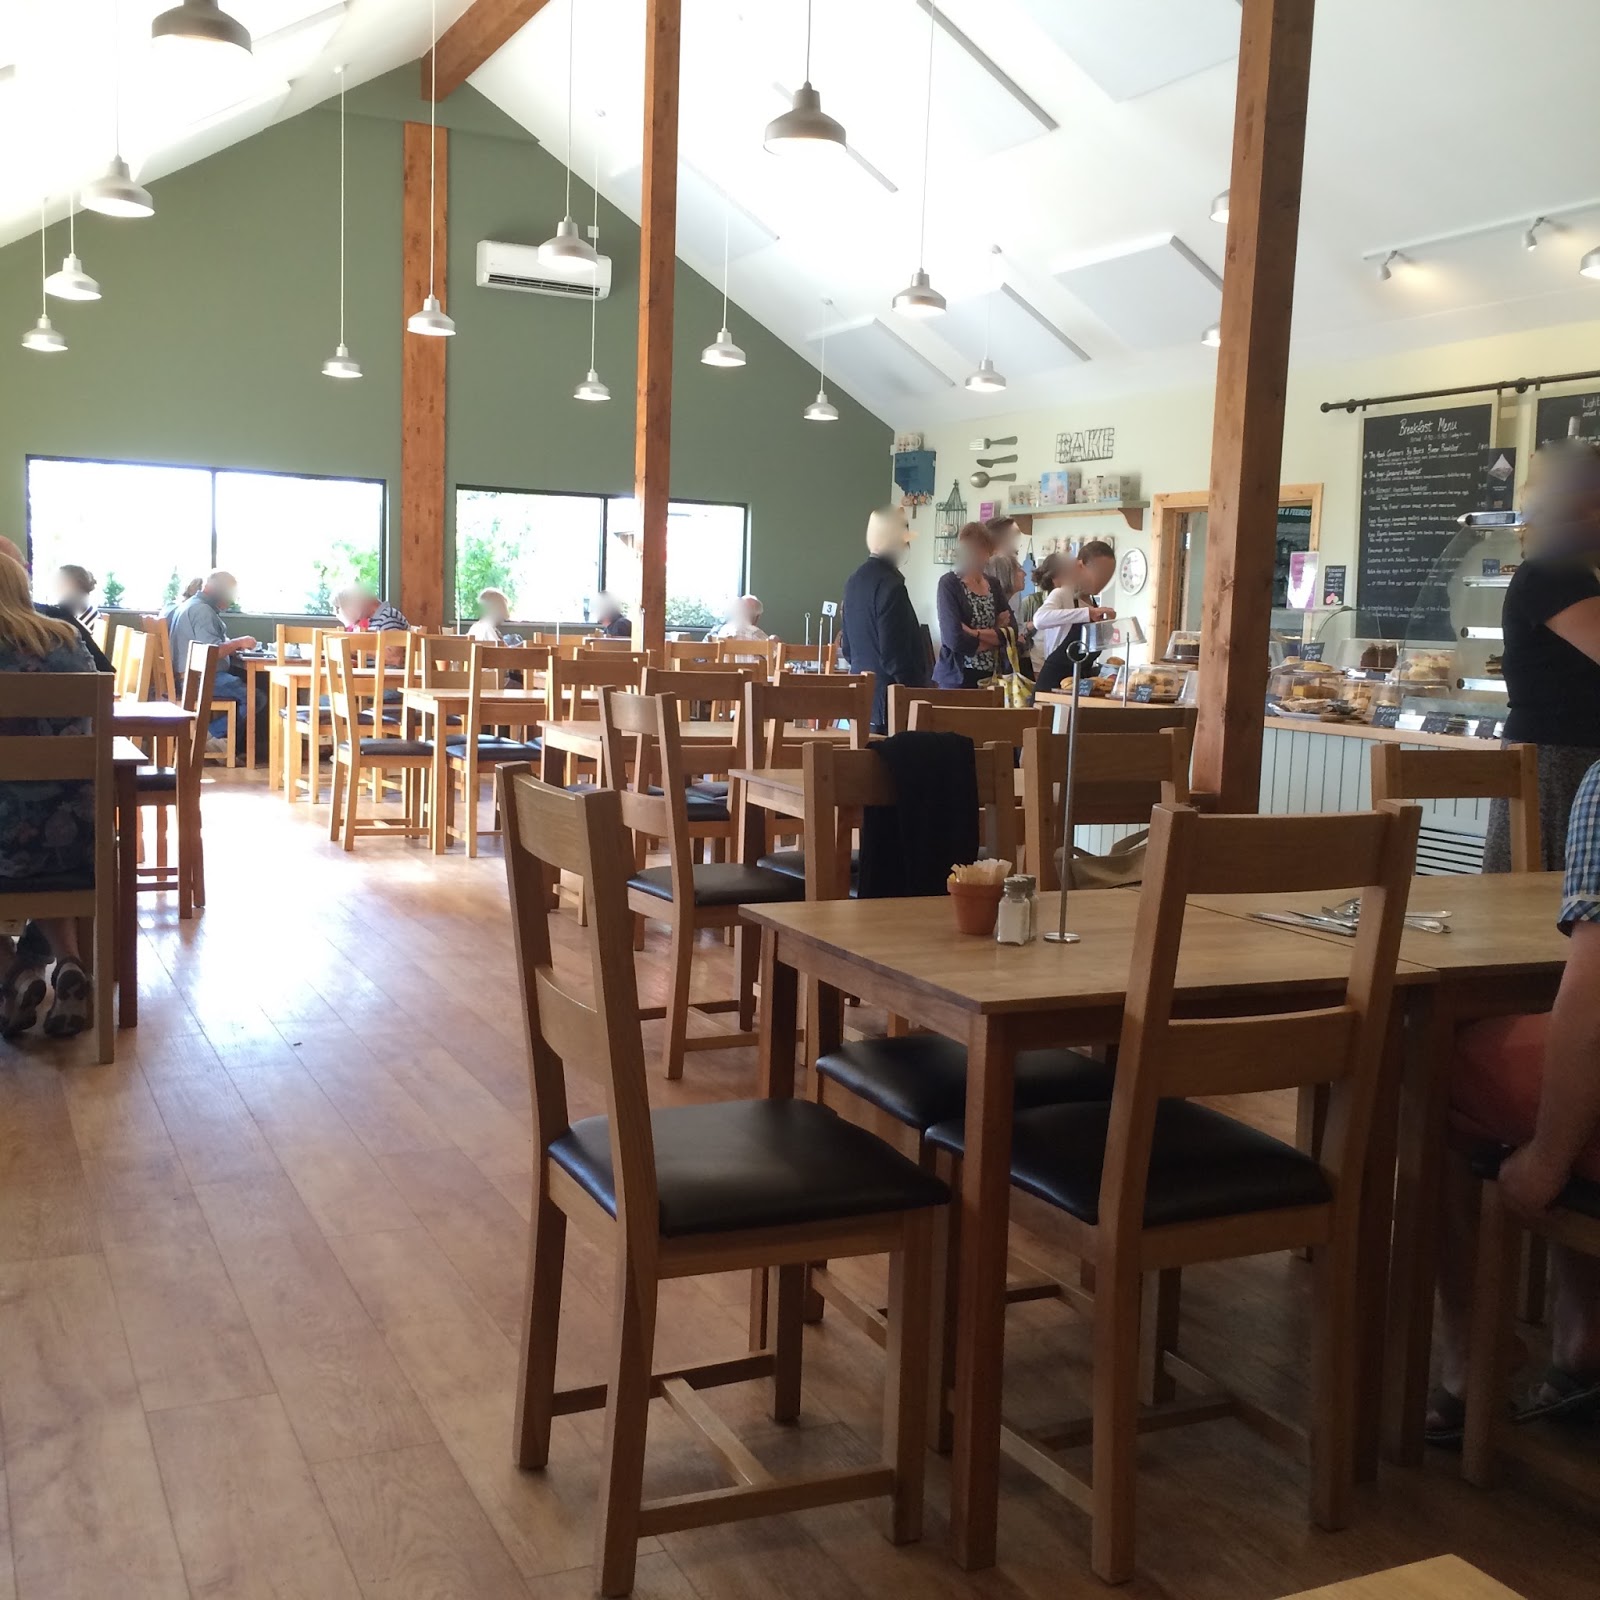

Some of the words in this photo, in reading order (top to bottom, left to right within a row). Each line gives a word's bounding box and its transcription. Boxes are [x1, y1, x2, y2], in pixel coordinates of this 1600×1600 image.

[1399, 418, 1433, 436] Breakfast
[1438, 416, 1458, 433] Menu
[1055, 427, 1115, 464] BAKE
[827, 604, 833, 613] 3
